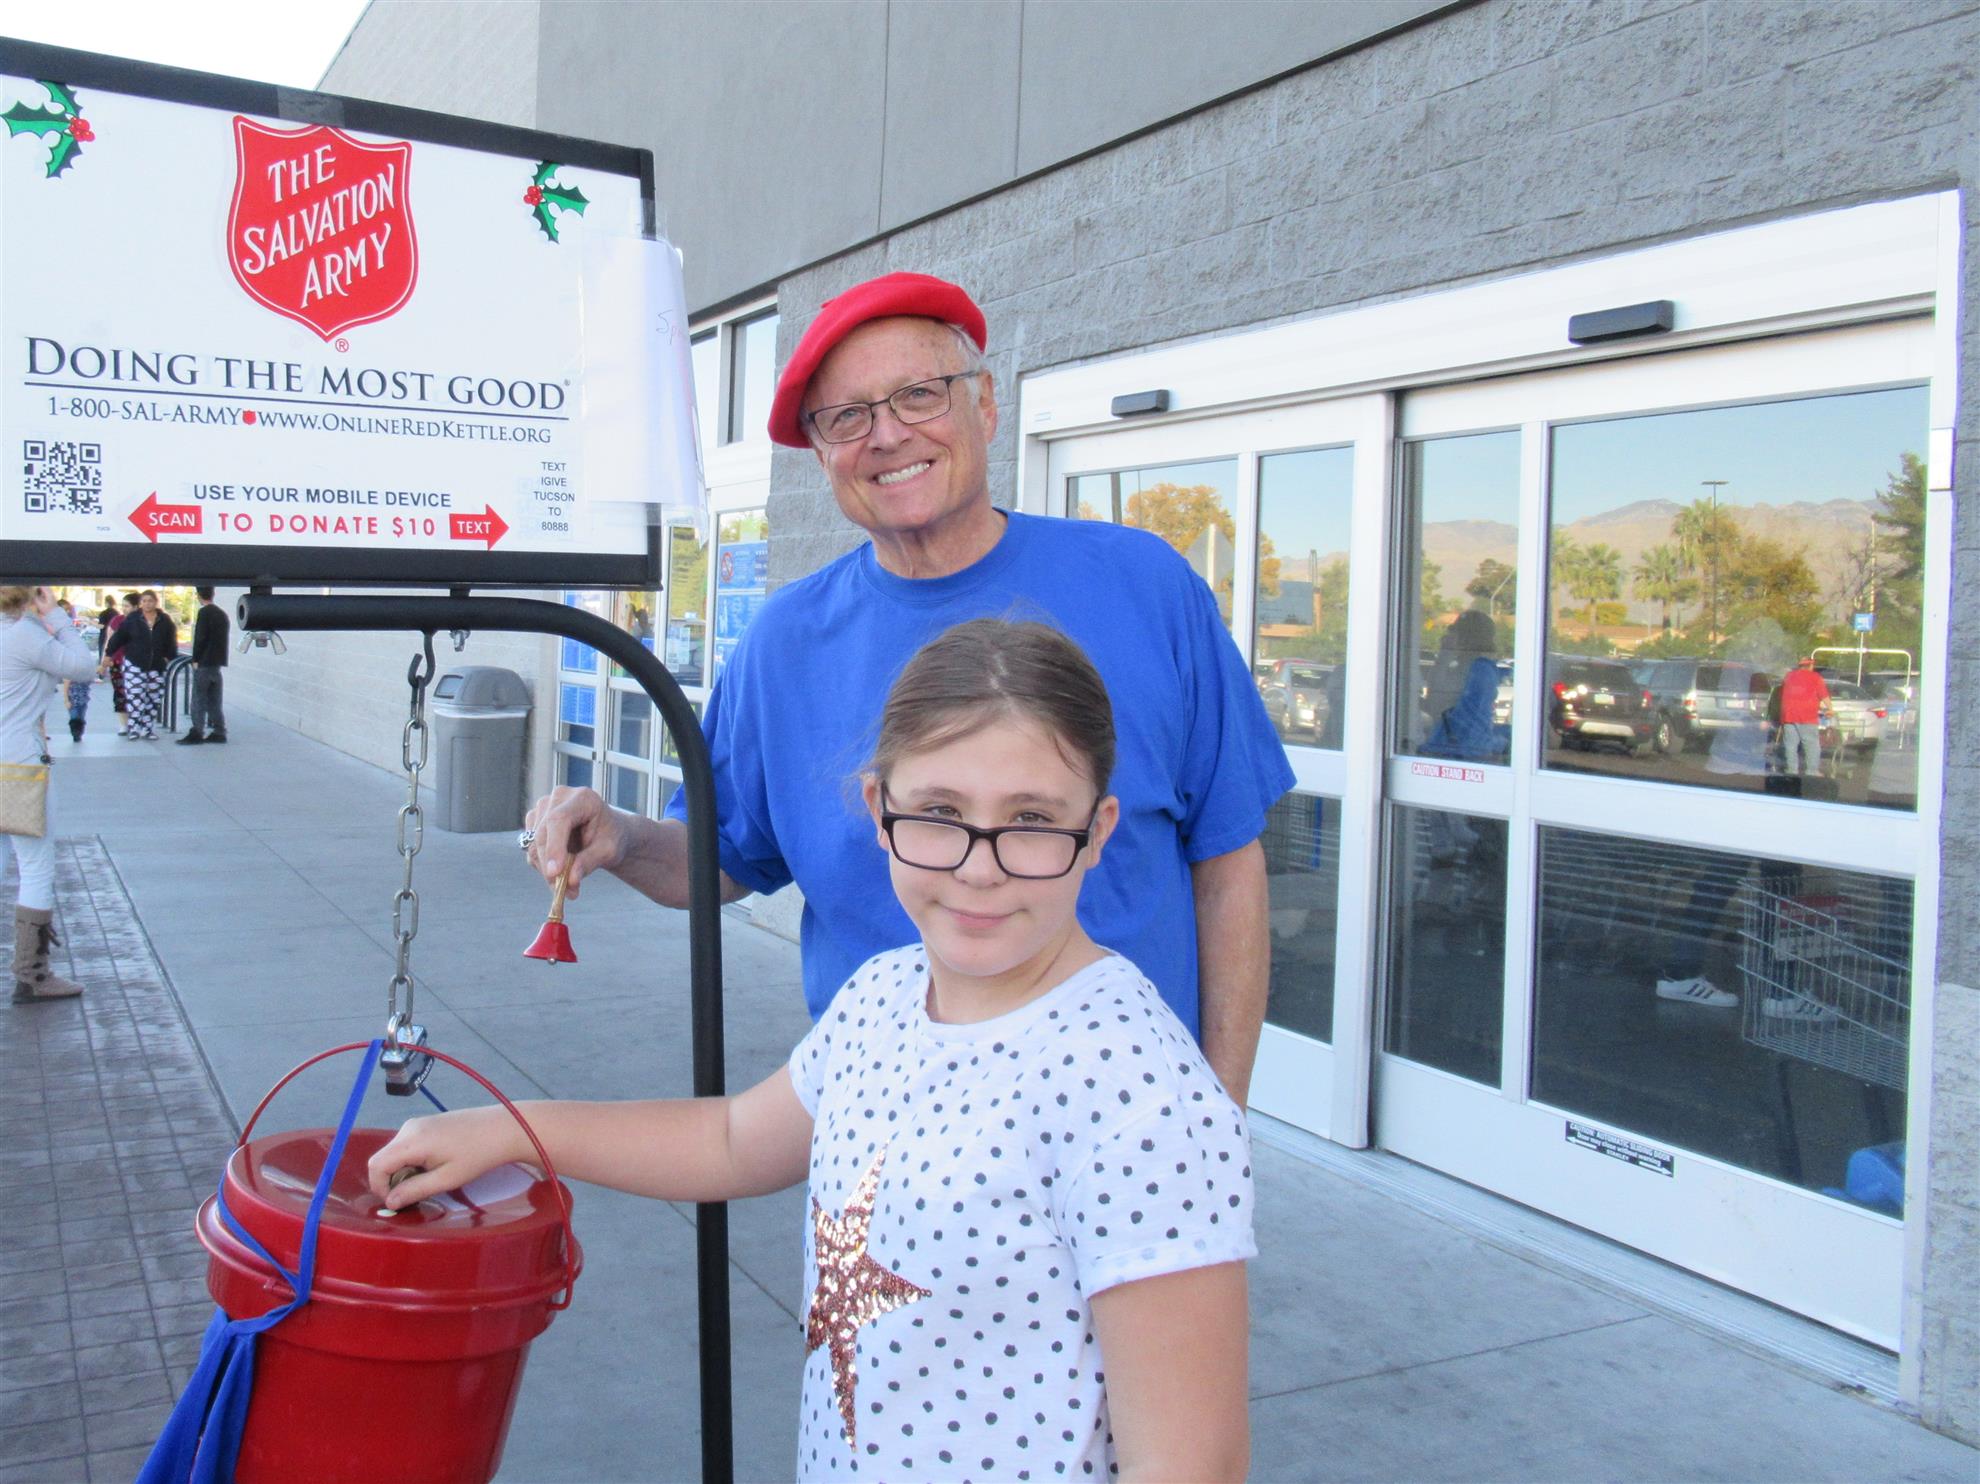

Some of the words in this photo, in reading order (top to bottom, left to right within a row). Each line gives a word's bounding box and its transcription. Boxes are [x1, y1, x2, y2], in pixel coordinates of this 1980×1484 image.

[267, 144, 337, 204] THE
[242, 162, 396, 275] SALVATION
[300, 222, 392, 309] ARMY
[24, 335, 200, 386] DOING
[214, 355, 304, 393] THE
[320, 365, 434, 401] MOST
[48, 396, 242, 426] 1-800-SAL-ARMY
[541, 461, 567, 472] TEXT
[541, 477, 567, 487] IGIVE
[193, 484, 236, 501] USE
[242, 486, 300, 503] YOUR
[306, 488, 379, 505] MOBILE
[385, 490, 452, 508] DEVICE
[533, 491, 576, 502] TUCSON
[148, 512, 196, 527] SCAN
[548, 506, 562, 517] TO
[218, 512, 253, 532] TO
[269, 514, 379, 535] DONATE
[392, 516, 436, 538] $10
[456, 520, 492, 535] TEXT
[541, 521, 569, 532] 80888
[1412, 763, 1440, 777] CAUTION
[1441, 767, 1463, 780] STAND
[1465, 770, 1483, 783] BACK
